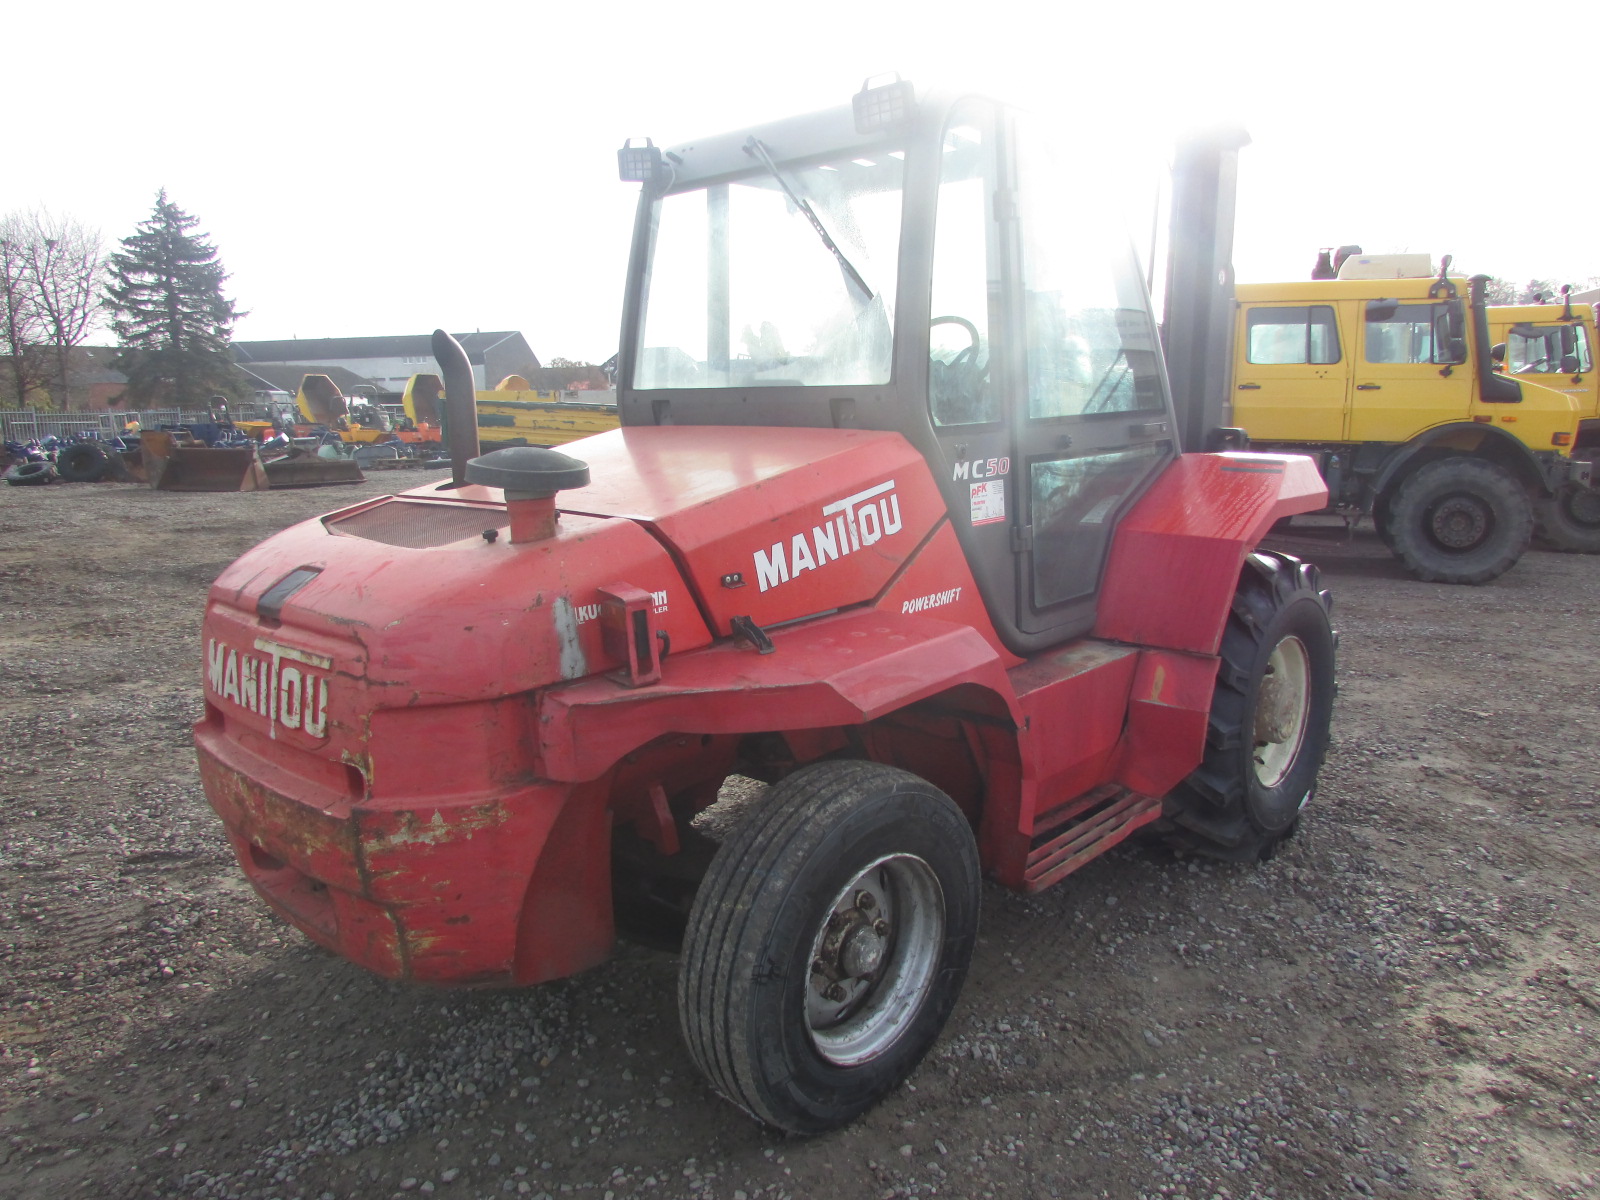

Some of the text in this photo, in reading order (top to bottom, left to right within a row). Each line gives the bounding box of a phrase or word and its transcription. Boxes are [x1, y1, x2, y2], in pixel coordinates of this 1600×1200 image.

[753, 479, 902, 593] MANITOU
[901, 587, 962, 614] POWERSHIFT
[208, 637, 333, 740] MANITOU
